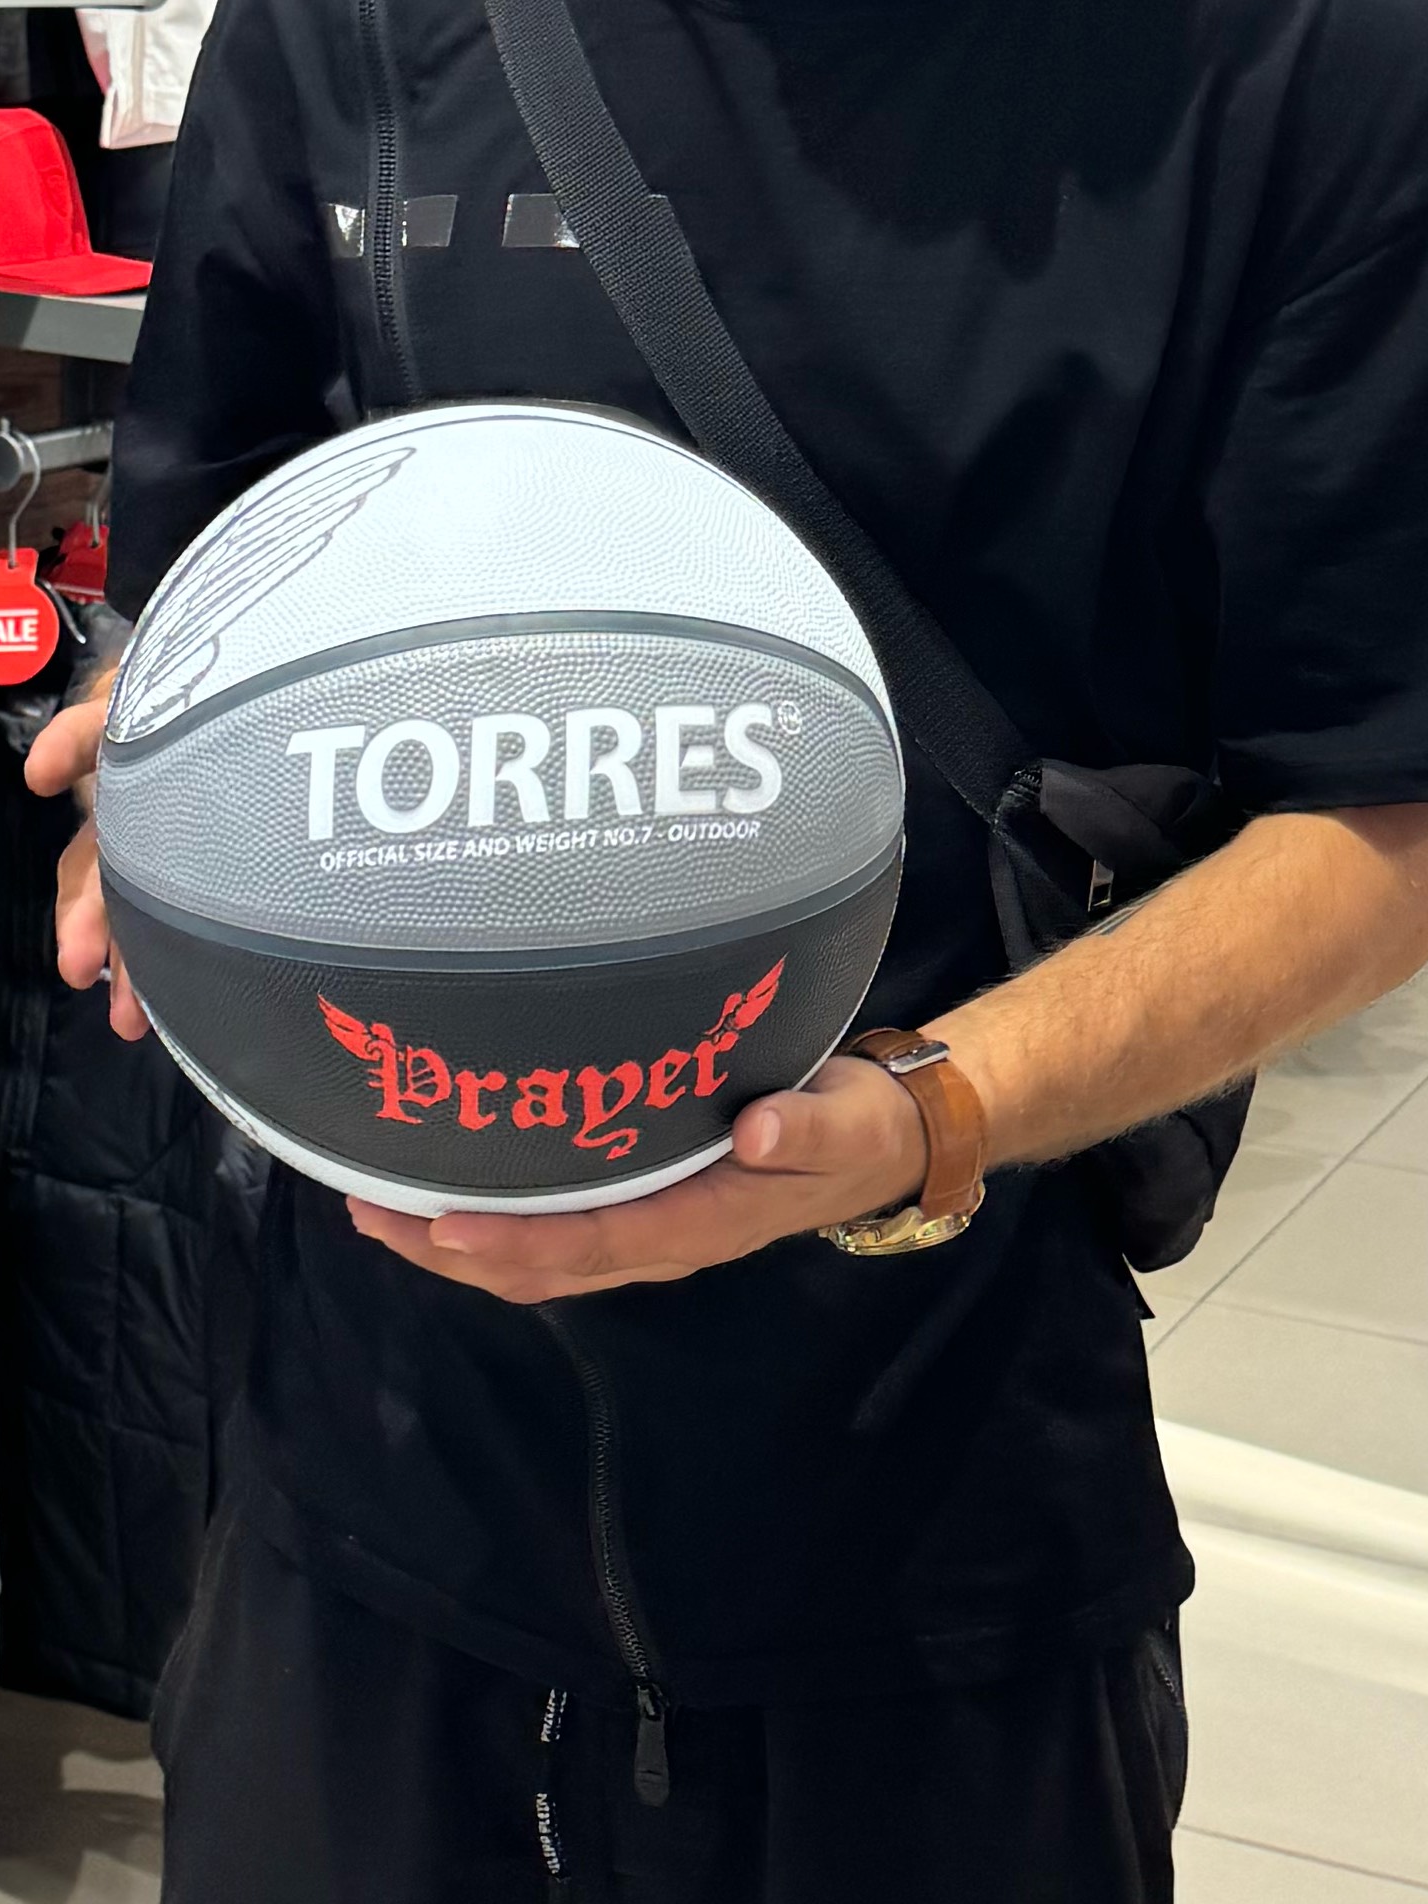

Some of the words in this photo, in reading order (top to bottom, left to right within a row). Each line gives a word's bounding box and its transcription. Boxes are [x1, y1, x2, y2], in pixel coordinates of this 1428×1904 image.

[285, 703, 783, 841] TORRES
[320, 843, 409, 872] OFFICIAL
[413, 840, 459, 863] SIZE
[461, 835, 510, 858] AND
[515, 828, 598, 854] WEIGHT
[603, 825, 655, 847] NO.7
[666, 819, 761, 842] OUTDOOR
[362, 1026, 742, 1161] Prayer
